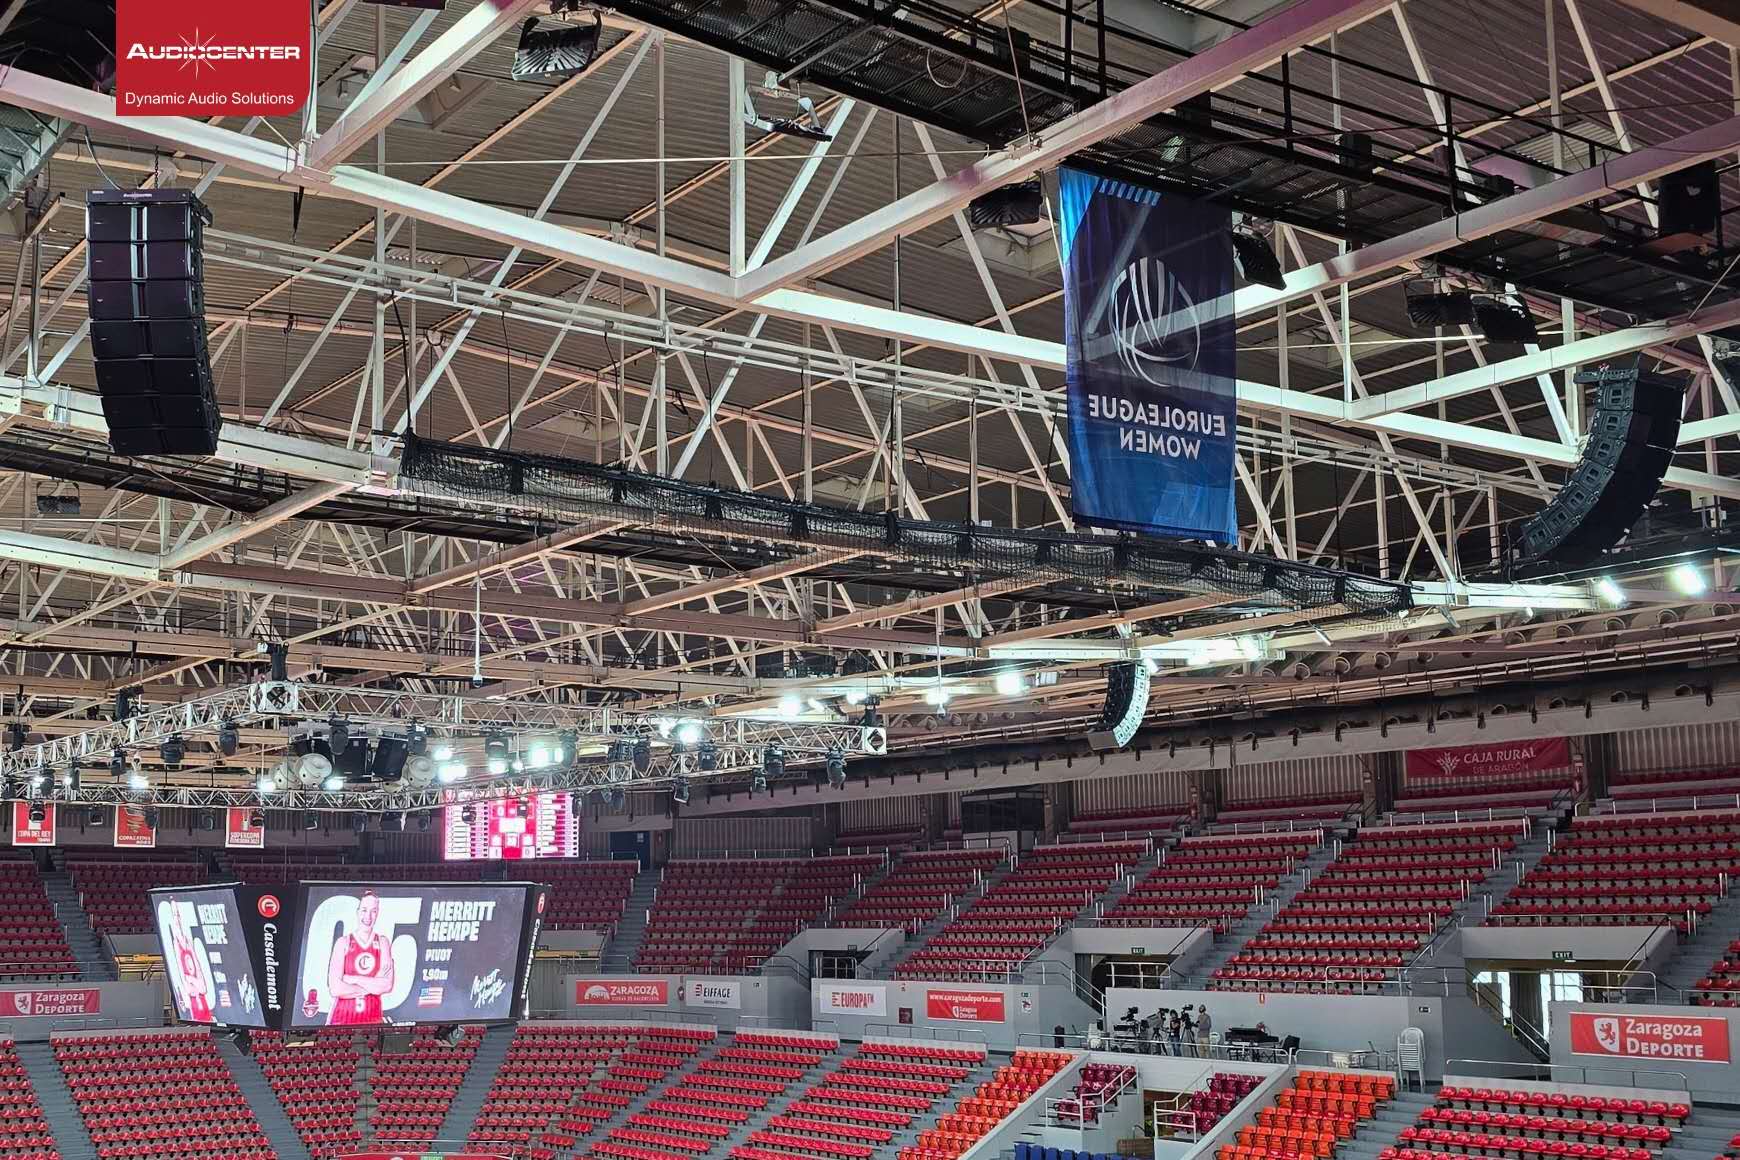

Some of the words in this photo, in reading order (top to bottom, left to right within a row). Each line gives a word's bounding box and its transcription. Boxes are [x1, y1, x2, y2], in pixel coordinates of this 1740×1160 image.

[1463, 751, 1494, 764] CAJA
[1496, 747, 1537, 761] RURAL
[430, 901, 496, 921] MERRITT
[427, 920, 480, 942] HEMPE
[425, 948, 453, 962] PIVOT
[263, 922, 281, 1011] Casademont
[35, 992, 85, 1004] Zaragoza
[610, 985, 659, 996] ZARAGOZA
[703, 987, 731, 998] EIFFAGE
[841, 992, 868, 1008] EUROPA
[35, 1004, 85, 1014] DEPORTE
[1625, 1018, 1703, 1040] Zaragoza
[1625, 1038, 1704, 1057] DEPORTE
